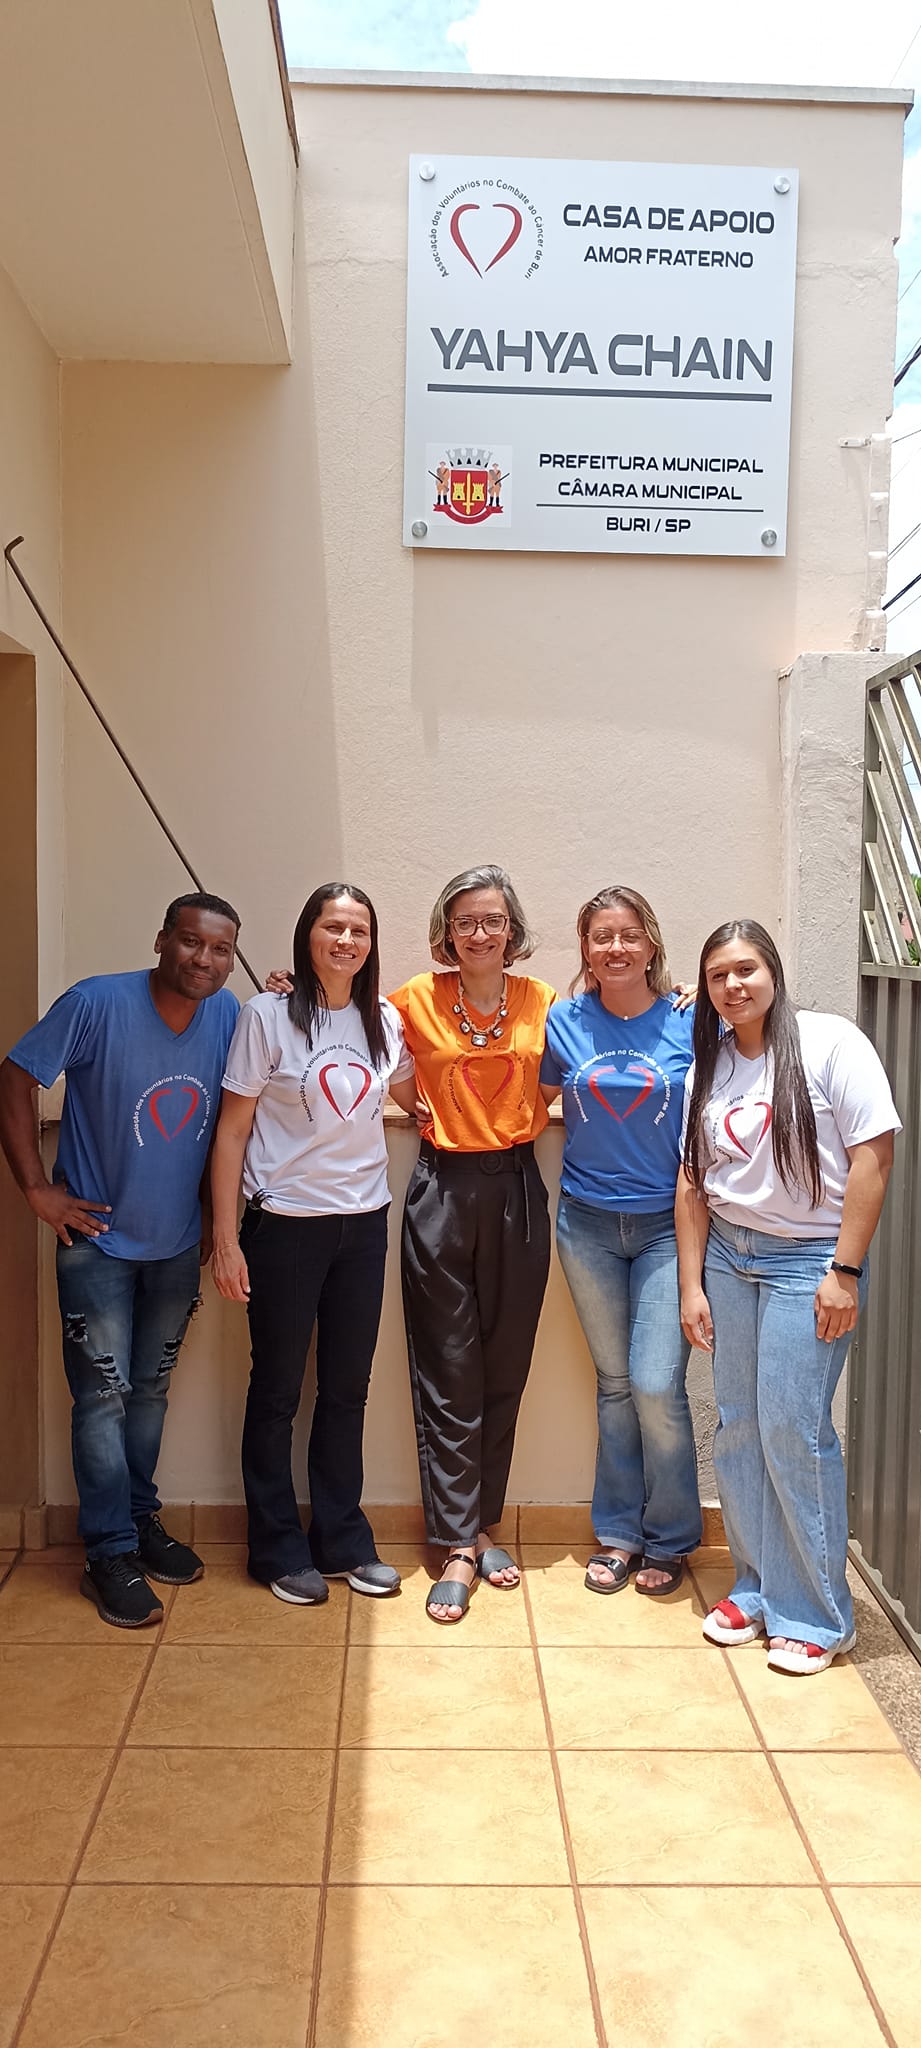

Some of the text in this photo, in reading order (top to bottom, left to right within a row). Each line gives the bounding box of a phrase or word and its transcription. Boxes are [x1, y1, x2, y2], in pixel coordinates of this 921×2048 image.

[429, 179, 544, 280] Associação dos Voluntários no Combate ao Câncer de Buri
[563, 203, 775, 234] CASA DE APOIO
[584, 246, 754, 268] AMOR FRATERNO
[430, 328, 773, 382] YAHYA CHAIN
[539, 454, 764, 473] PREFEITURA MUNICIPAL
[558, 478, 743, 501] CÂMARA MUNICIPAL
[606, 517, 691, 533] BURI / SP
